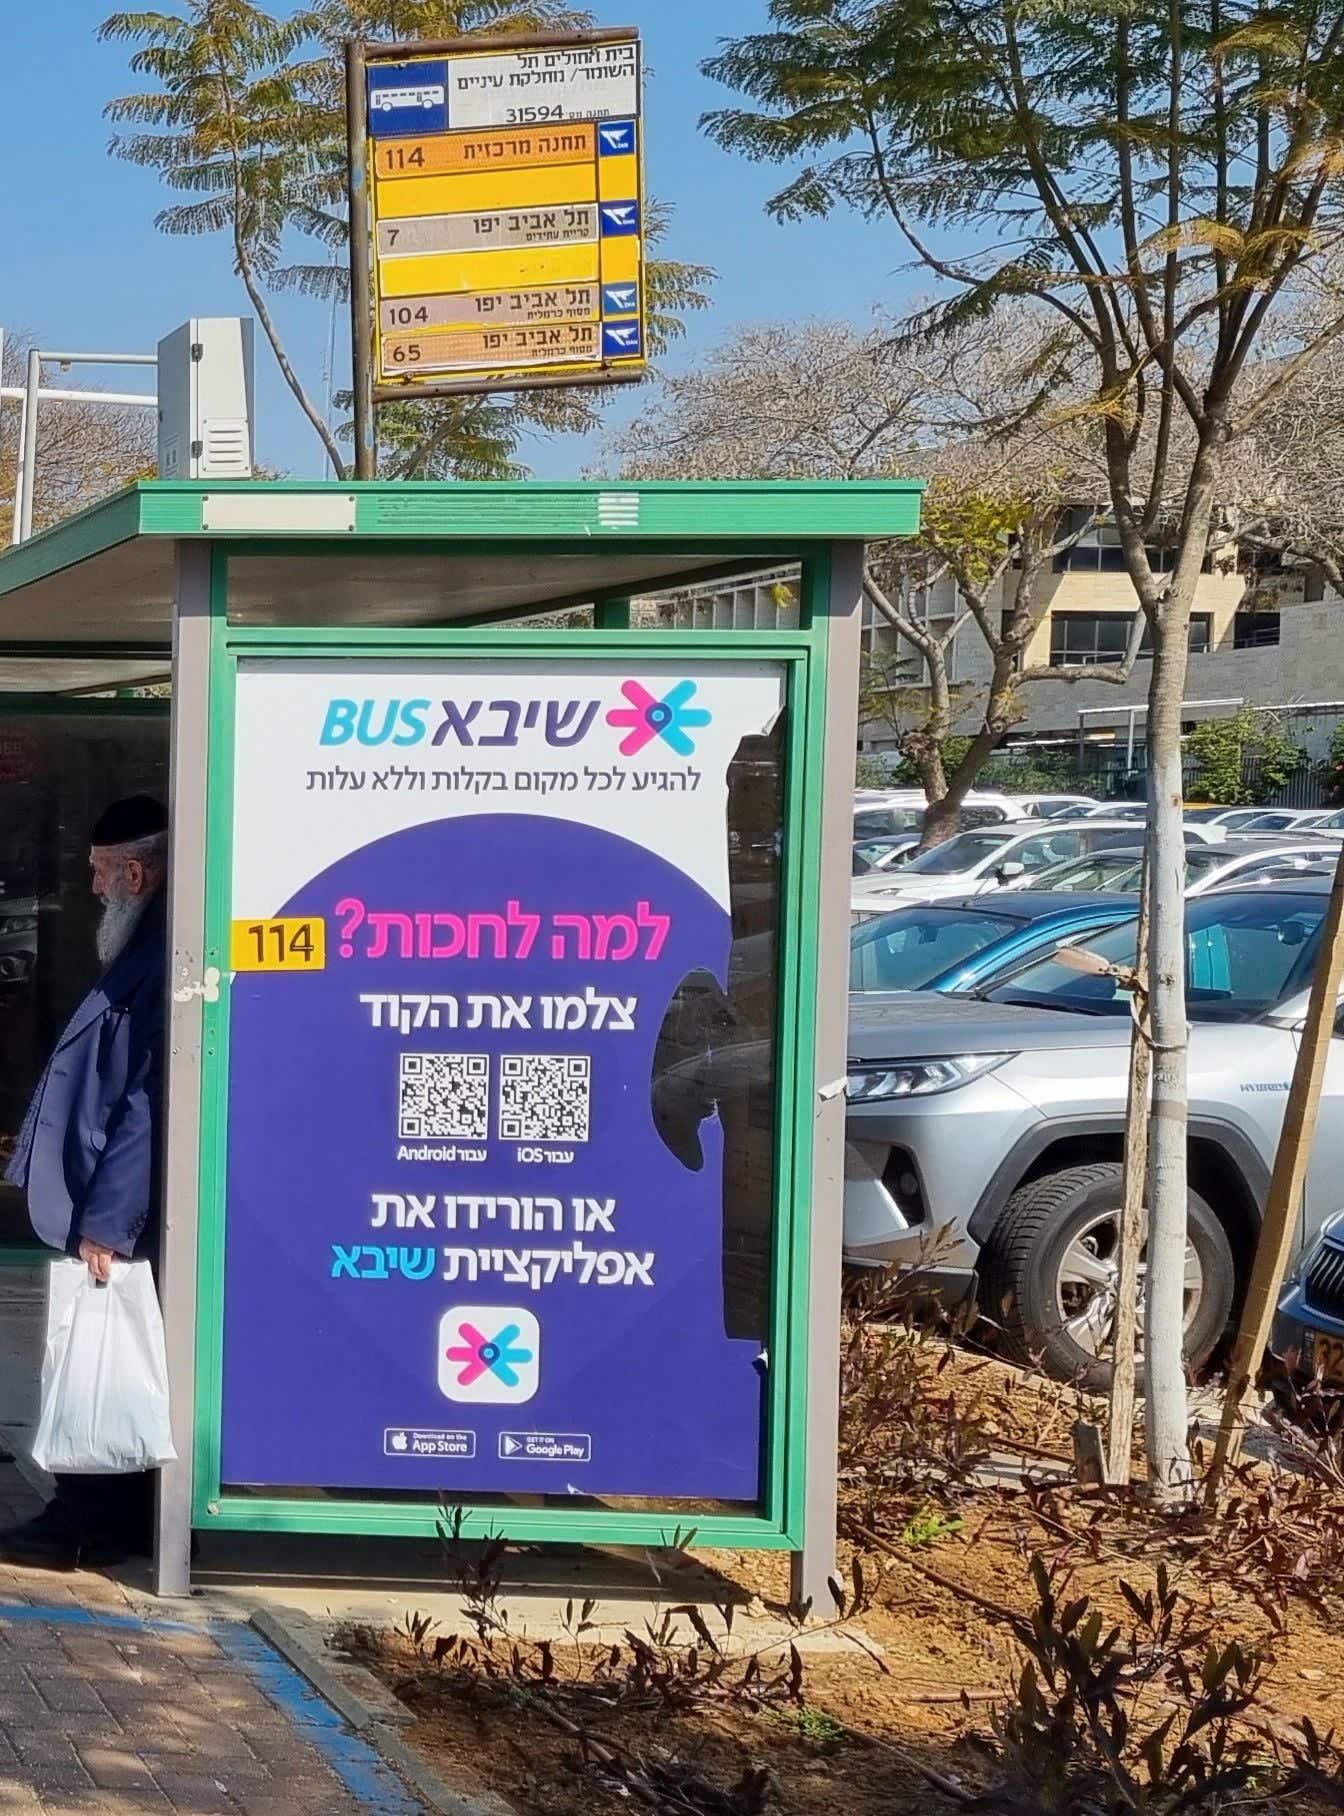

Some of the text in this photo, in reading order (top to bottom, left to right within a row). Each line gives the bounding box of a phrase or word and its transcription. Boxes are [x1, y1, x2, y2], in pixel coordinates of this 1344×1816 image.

[517, 54, 539, 69] תל
[605, 46, 635, 62] בית
[457, 74, 504, 91] עיניים
[509, 69, 565, 88] מחלקת
[505, 104, 565, 123] 31594
[385, 134, 586, 170] תחנה מרכזית 114
[387, 207, 590, 247] תל אביב יפו 7
[389, 287, 591, 325] תל אביב יפו 104
[392, 325, 594, 362] תל אביב יפו 65
[318, 698, 602, 748] שיבא BUS
[305, 765, 702, 795] להגיע לכל מקום בקלות וללא עלות
[247, 924, 315, 964] 114
[334, 897, 672, 961] למה לחכות?
[359, 986, 638, 1034] צלמו את הקוד
[396, 1144, 488, 1162] עבור Android
[517, 1147, 575, 1164] עבור iOS
[371, 1193, 617, 1233] או הורידו את
[330, 1241, 656, 1290] אפליקציית שיבא
[412, 1440, 468, 1454] App Store
[526, 1444, 585, 1459] Google Play
